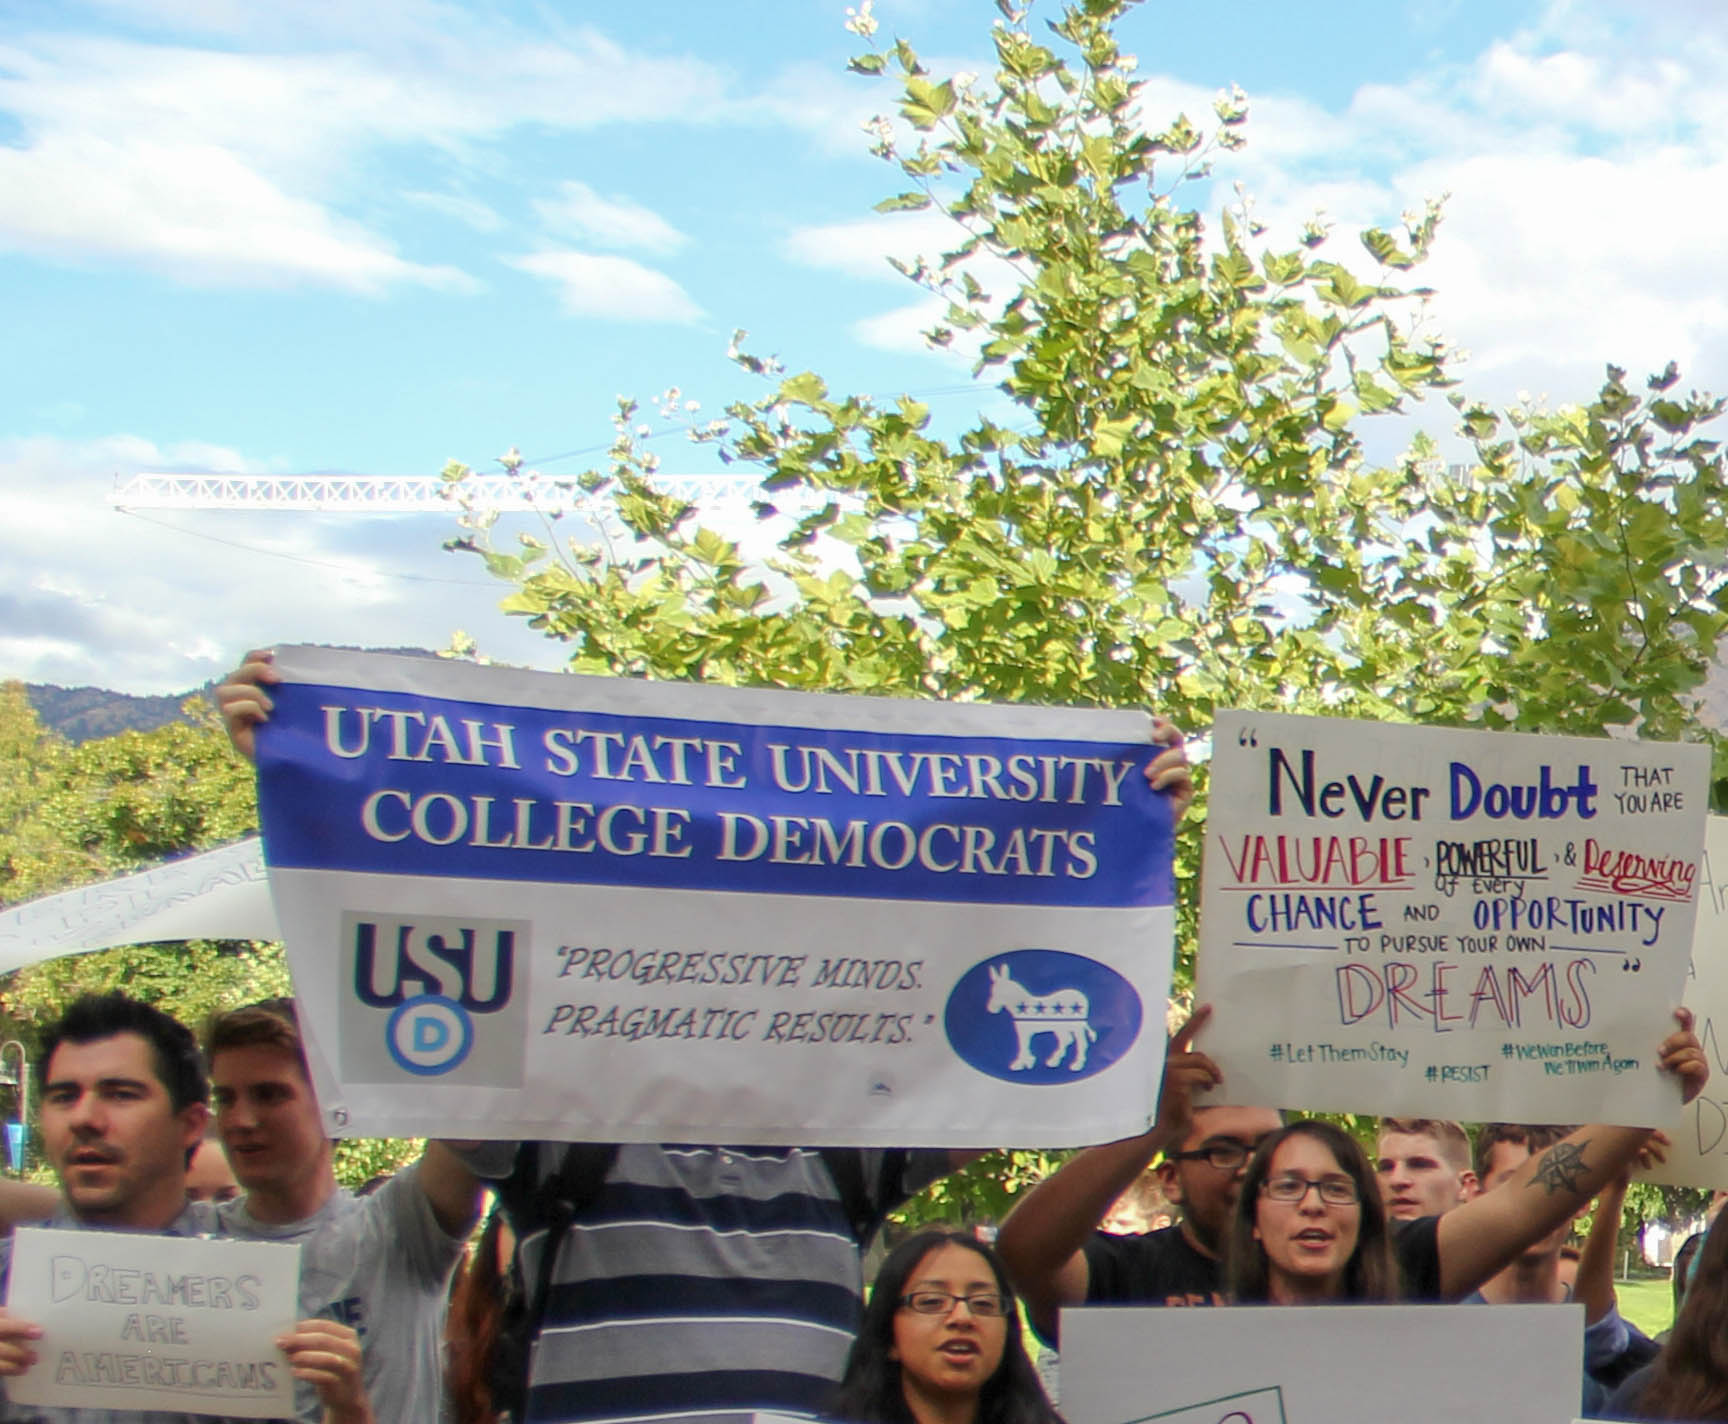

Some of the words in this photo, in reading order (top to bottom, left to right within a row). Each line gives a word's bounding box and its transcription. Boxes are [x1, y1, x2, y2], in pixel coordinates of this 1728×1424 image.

[321, 706, 522, 769] UTAH
[543, 728, 747, 789] STATE
[768, 744, 1136, 806] UNIVERSITY
[1449, 762, 1597, 821] Doubt
[1620, 766, 1675, 788] THAT
[1614, 793, 1649, 813] YOU
[1650, 792, 1684, 811] ARE
[362, 789, 693, 859] COLLEGE
[716, 812, 1098, 879] DEMOCRATS
[1564, 842, 1576, 868] &
[1584, 838, 1697, 895] Deserving
[1247, 893, 1383, 933] CHANCE
[1404, 903, 1440, 922] AND
[1344, 937, 1370, 954] TO
[1381, 935, 1448, 953] PURSUE
[1458, 936, 1500, 953] YOUR
[1506, 935, 1547, 952] OWN
[354, 922, 515, 1013] USU
[812, 959, 922, 990] MINDS.
[413, 1016, 450, 1052] D
[543, 1005, 750, 1042] PRAGMATIC
[1425, 1065, 1491, 1083] #RESIST
[51, 1256, 262, 1310] DREAMERS
[121, 1313, 191, 1344] ARE
[56, 1351, 278, 1390] AMERICANS
